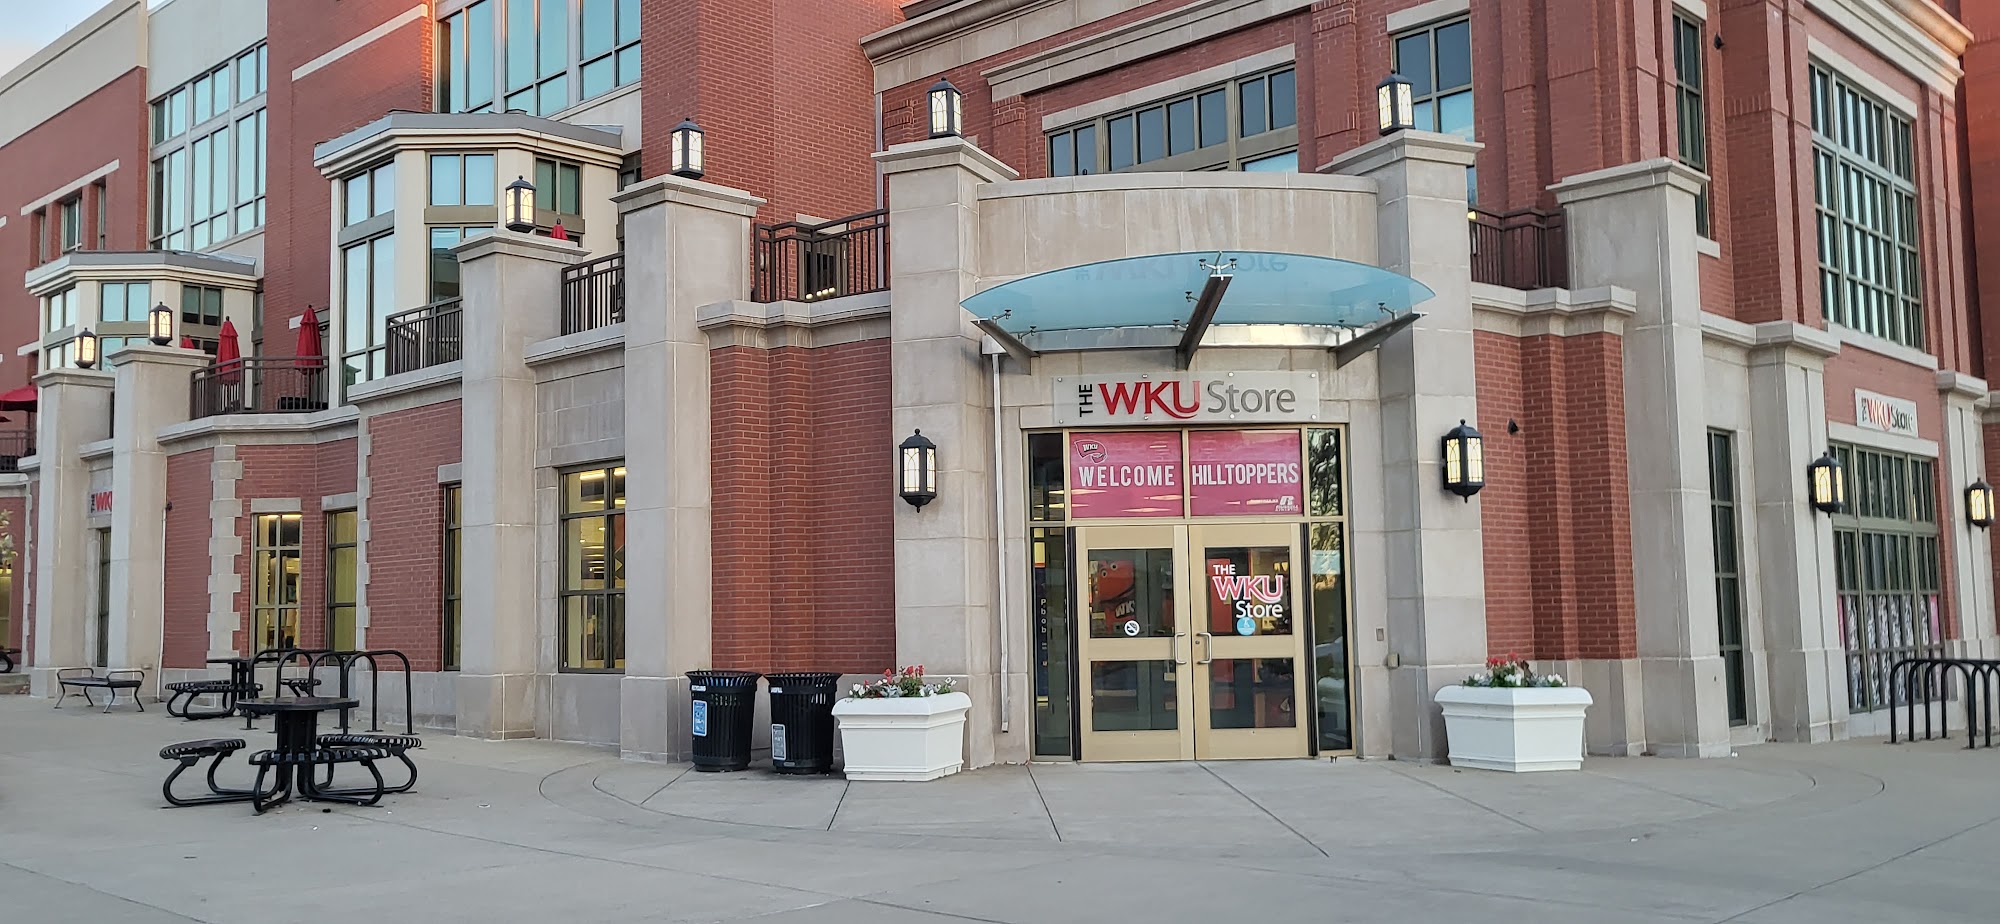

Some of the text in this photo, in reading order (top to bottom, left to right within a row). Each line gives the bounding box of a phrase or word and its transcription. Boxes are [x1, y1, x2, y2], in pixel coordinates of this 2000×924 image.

[1078, 380, 1296, 419] THE WKU Store
[1867, 398, 1891, 432] WKU
[1083, 443, 1099, 452] WKU
[1079, 464, 1175, 487] WELCOME
[1191, 463, 1299, 486] HILLTOPPERS
[95, 491, 112, 512] WK
[1213, 564, 1236, 575] THE
[1212, 575, 1283, 604] WKU
[1235, 600, 1283, 618] Store
